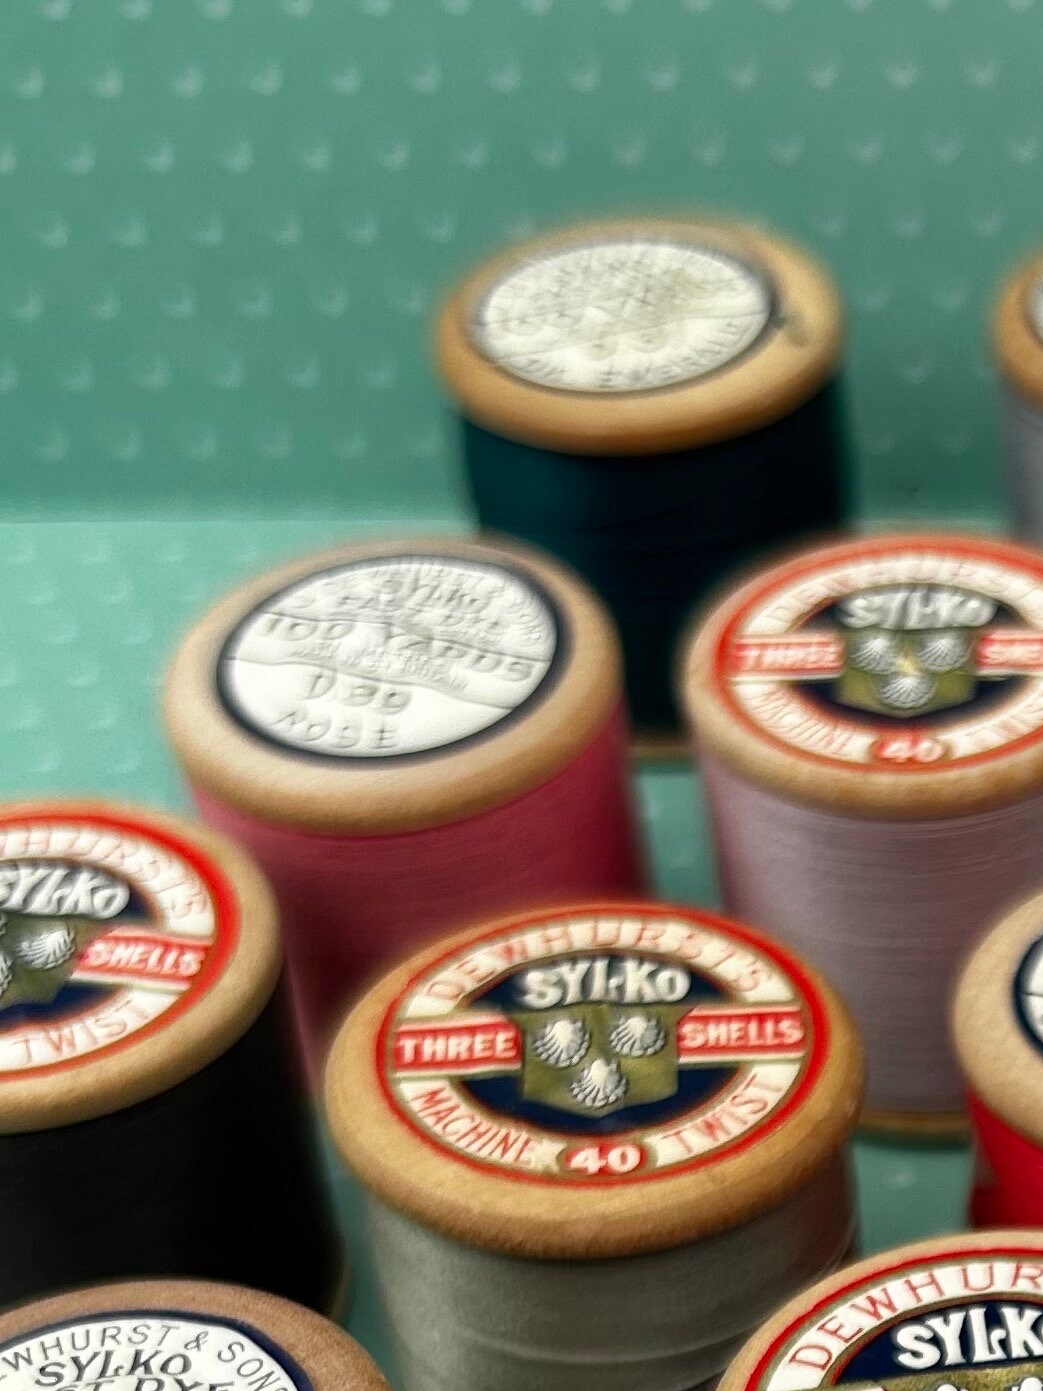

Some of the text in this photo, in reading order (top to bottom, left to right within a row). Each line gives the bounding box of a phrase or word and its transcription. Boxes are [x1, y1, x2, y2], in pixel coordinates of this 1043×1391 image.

[836, 586, 997, 629] SYLKO
[259, 615, 352, 642] 100
[878, 738, 944, 763] 40
[92, 942, 205, 977] SHELLS
[524, 957, 692, 1009] SYLKO
[400, 1016, 805, 1064] THREE SHELLS
[416, 1086, 540, 1167] MACHINE
[668, 1075, 785, 1158] TWIST
[570, 1146, 643, 1174] 40
[184, 1331, 209, 1352] &
[35, 1349, 193, 1388] SYLKO
